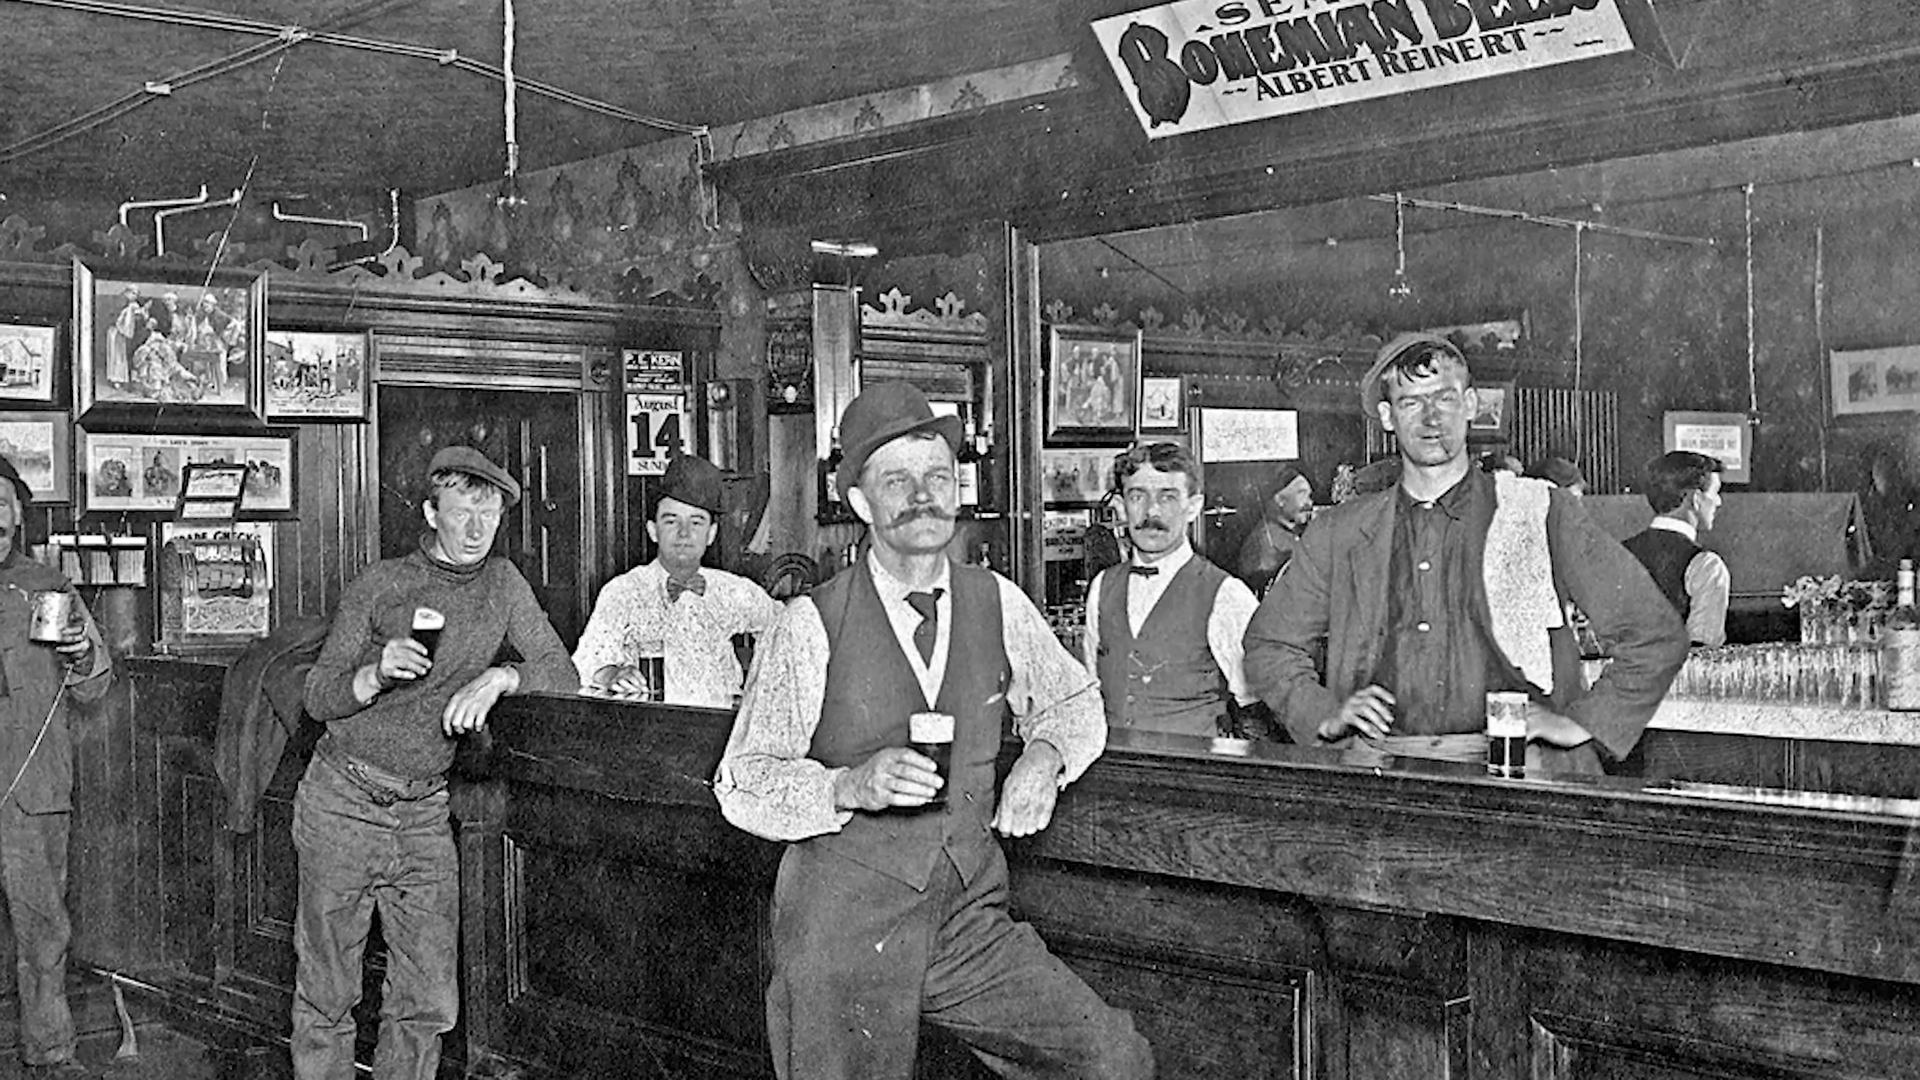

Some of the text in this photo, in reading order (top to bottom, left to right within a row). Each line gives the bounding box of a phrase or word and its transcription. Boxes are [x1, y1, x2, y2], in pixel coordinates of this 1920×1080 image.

[1118, 0, 1423, 128] BOHEMIAN
[1257, 28, 1527, 101] ALBERT REINERT
[634, 395, 678, 412] August
[631, 412, 684, 458] 14
